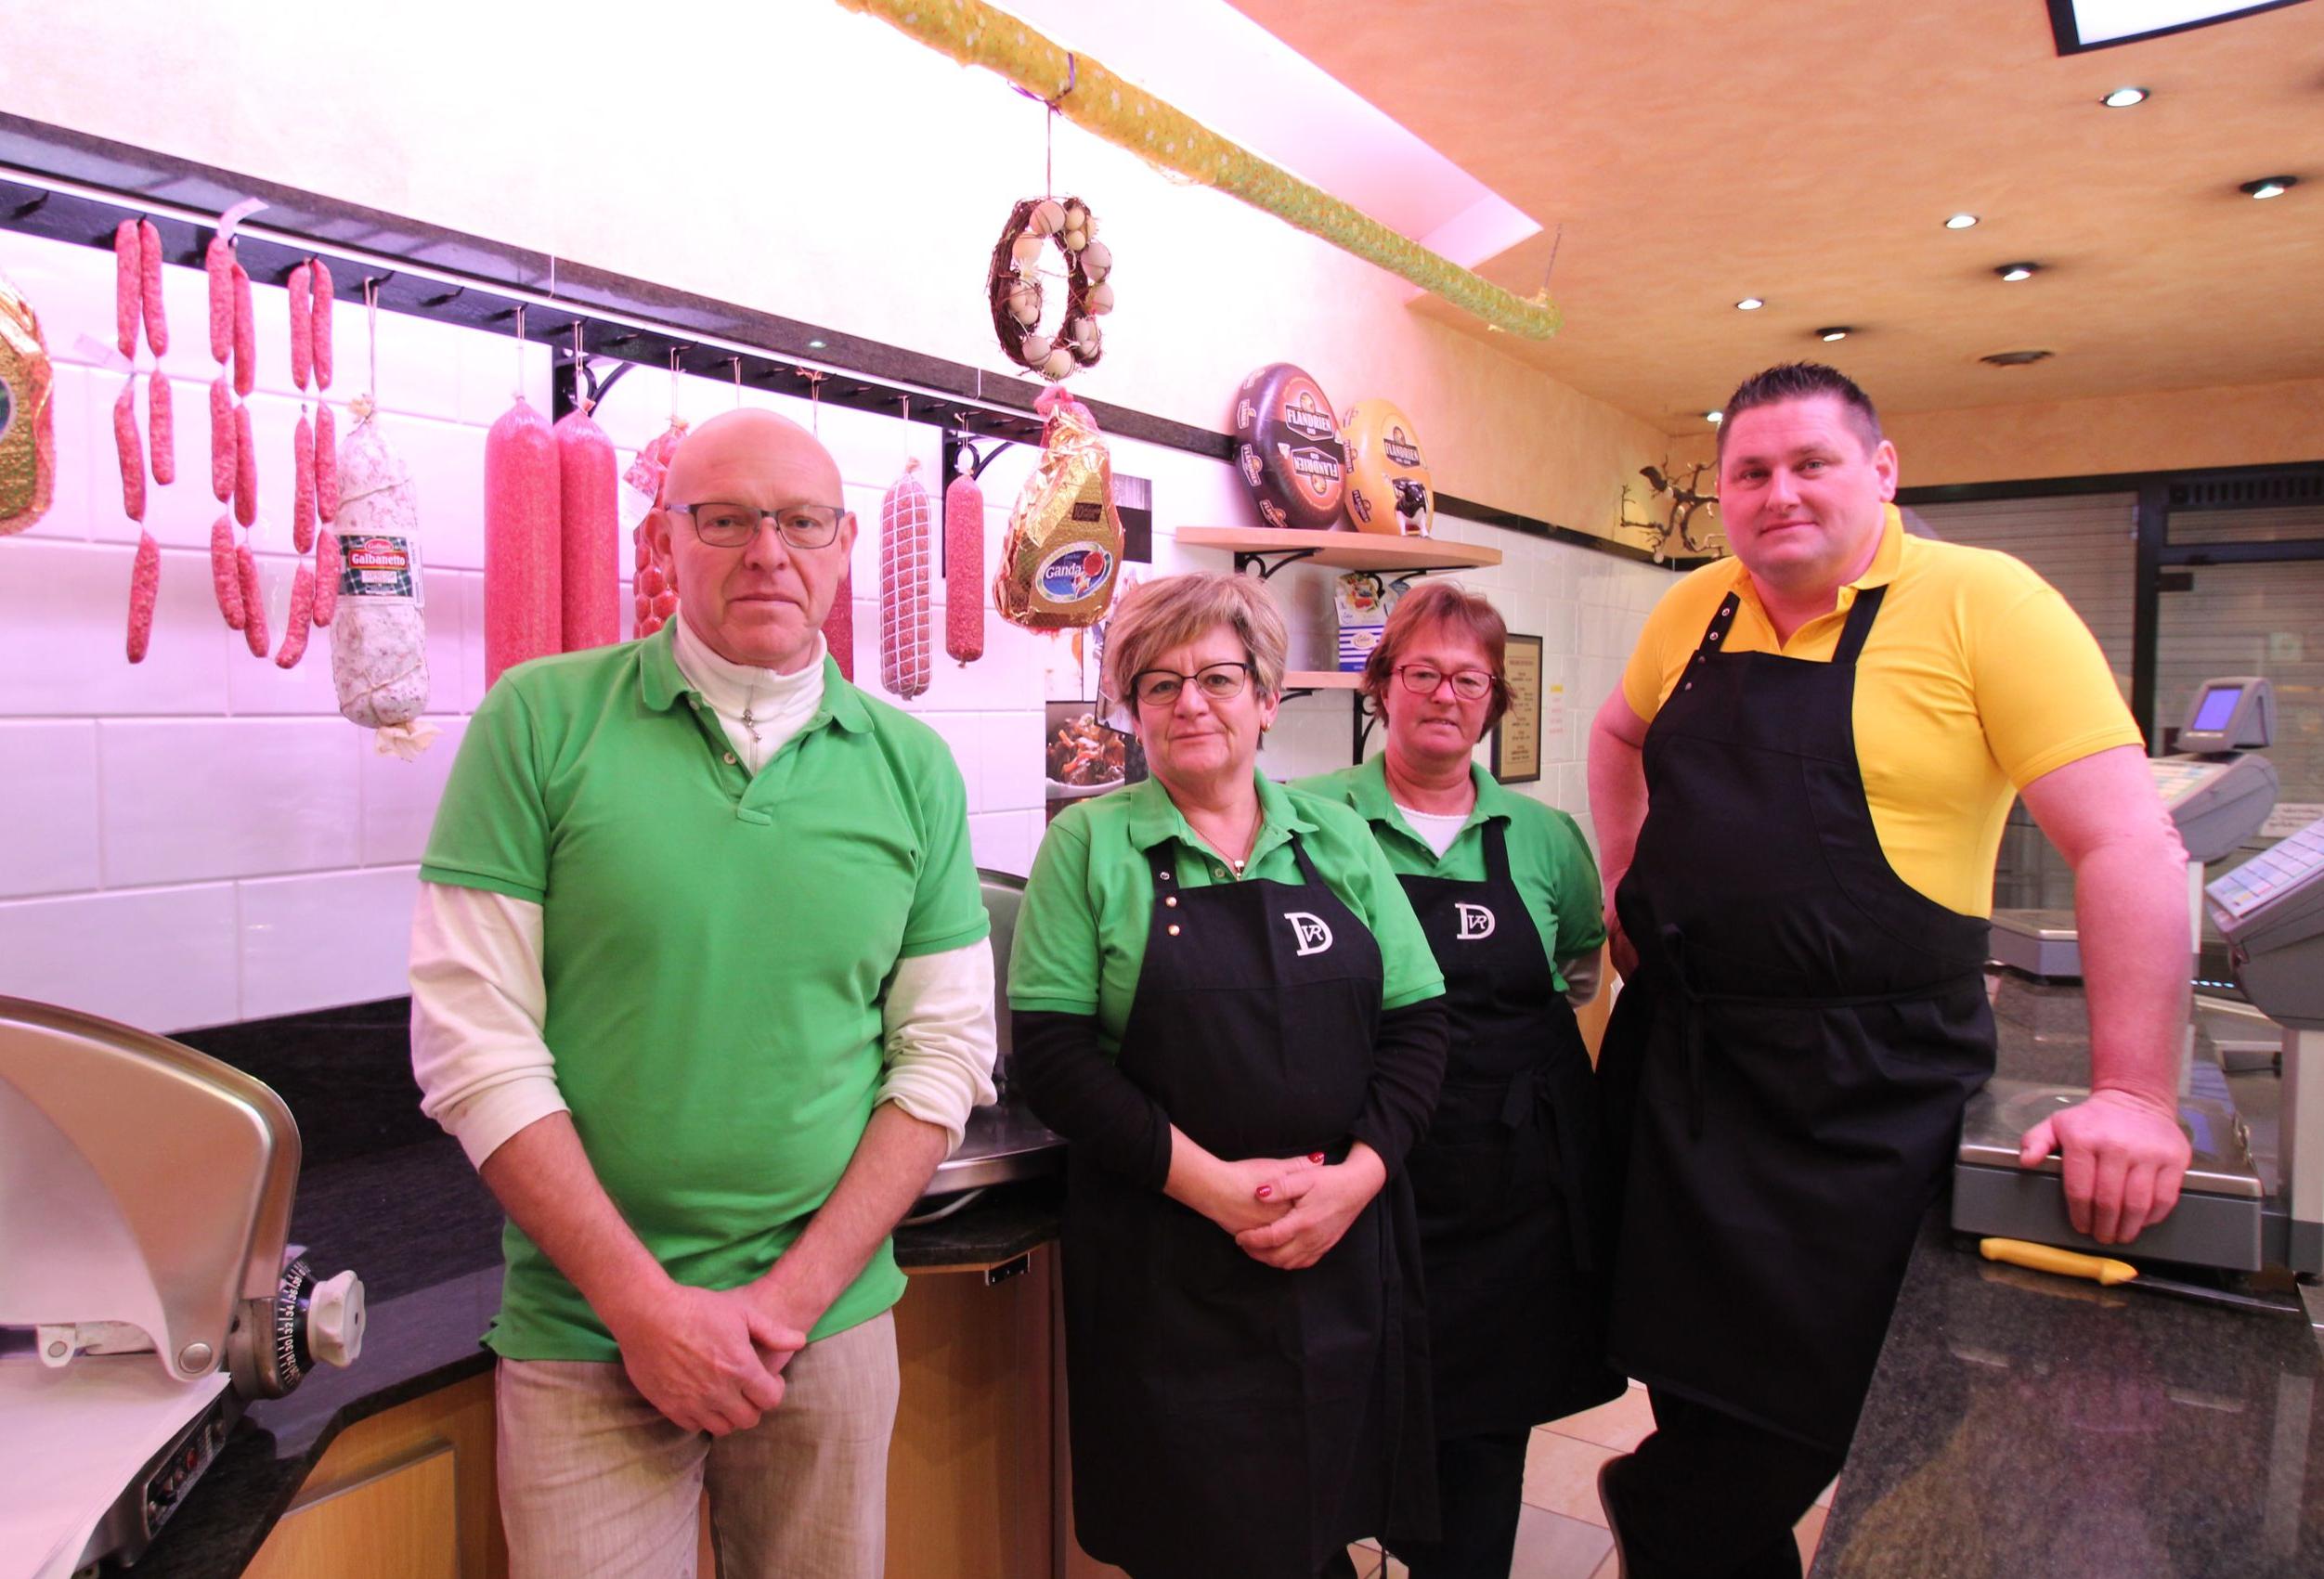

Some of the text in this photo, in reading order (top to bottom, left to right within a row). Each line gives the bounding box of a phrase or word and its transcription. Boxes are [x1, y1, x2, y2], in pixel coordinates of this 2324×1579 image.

[1286, 408, 1332, 432] FLANDRIEN
[1292, 456, 1339, 477] FLANDRIEN
[352, 552, 406, 566] Galbanetto
[1045, 563, 1082, 579] Ganda
[284, 1322, 293, 1335] 32
[284, 1339, 293, 1352] 30
